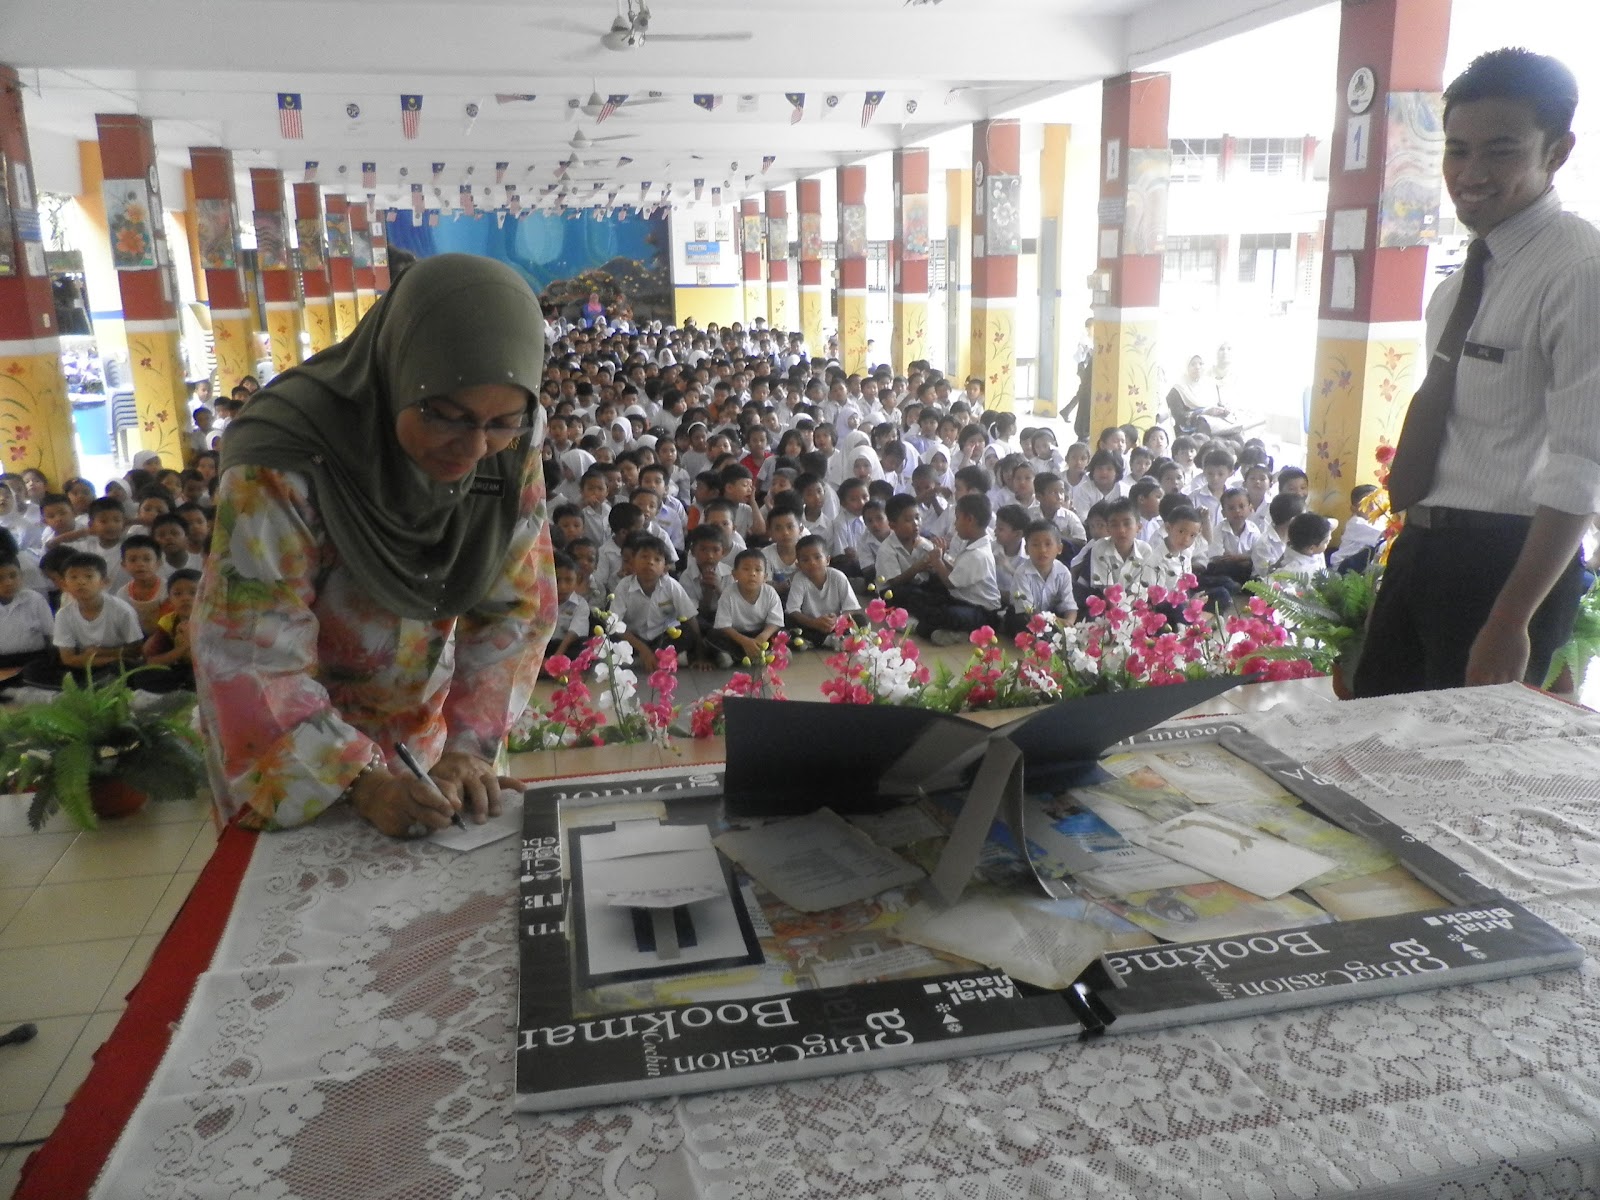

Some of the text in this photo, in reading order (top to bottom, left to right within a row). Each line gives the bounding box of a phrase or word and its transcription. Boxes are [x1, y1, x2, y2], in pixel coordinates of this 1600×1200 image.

[1353, 125, 1362, 162] 1
[1443, 907, 1515, 925] Black
[1461, 916, 1515, 936] Arial
[949, 985, 1014, 1006] Arial
